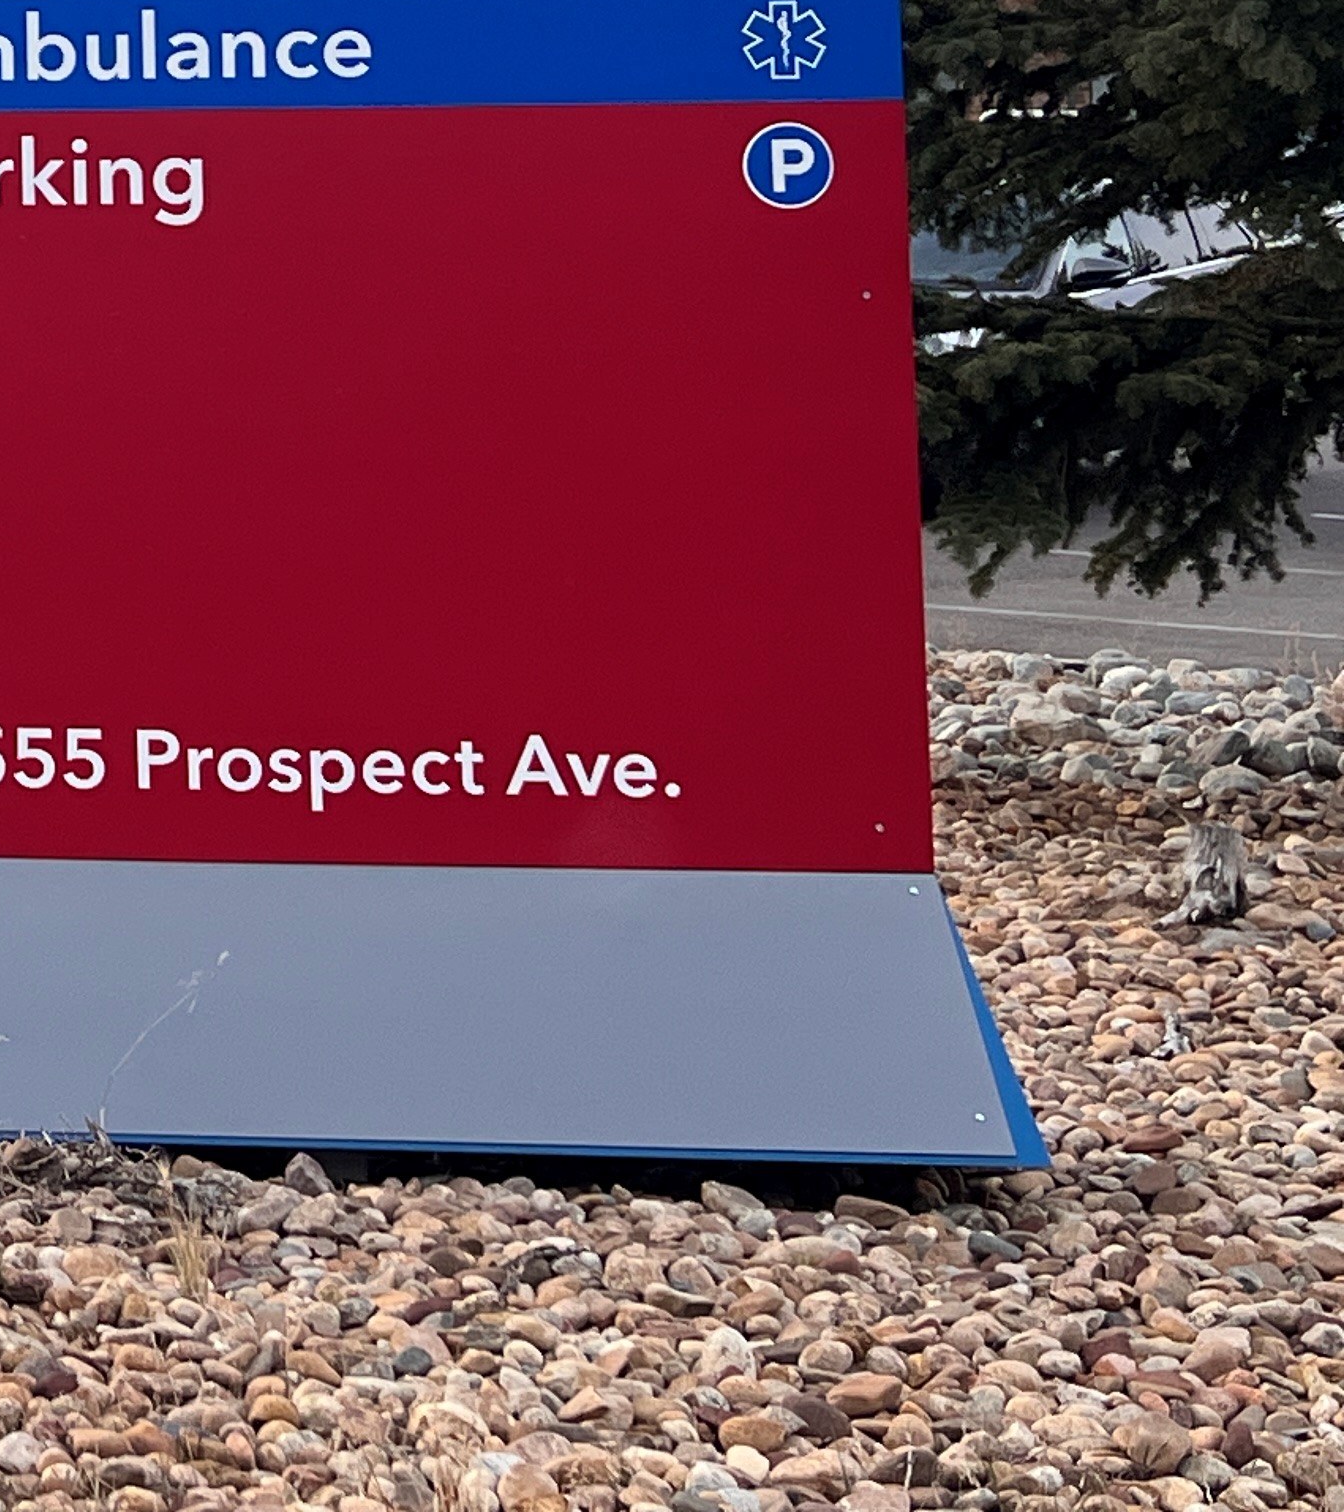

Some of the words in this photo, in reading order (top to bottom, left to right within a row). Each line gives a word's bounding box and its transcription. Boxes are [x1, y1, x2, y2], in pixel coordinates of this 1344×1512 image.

[768, 140, 816, 193] P
[136, 729, 485, 812] Prospect
[506, 734, 681, 798] Ave.
